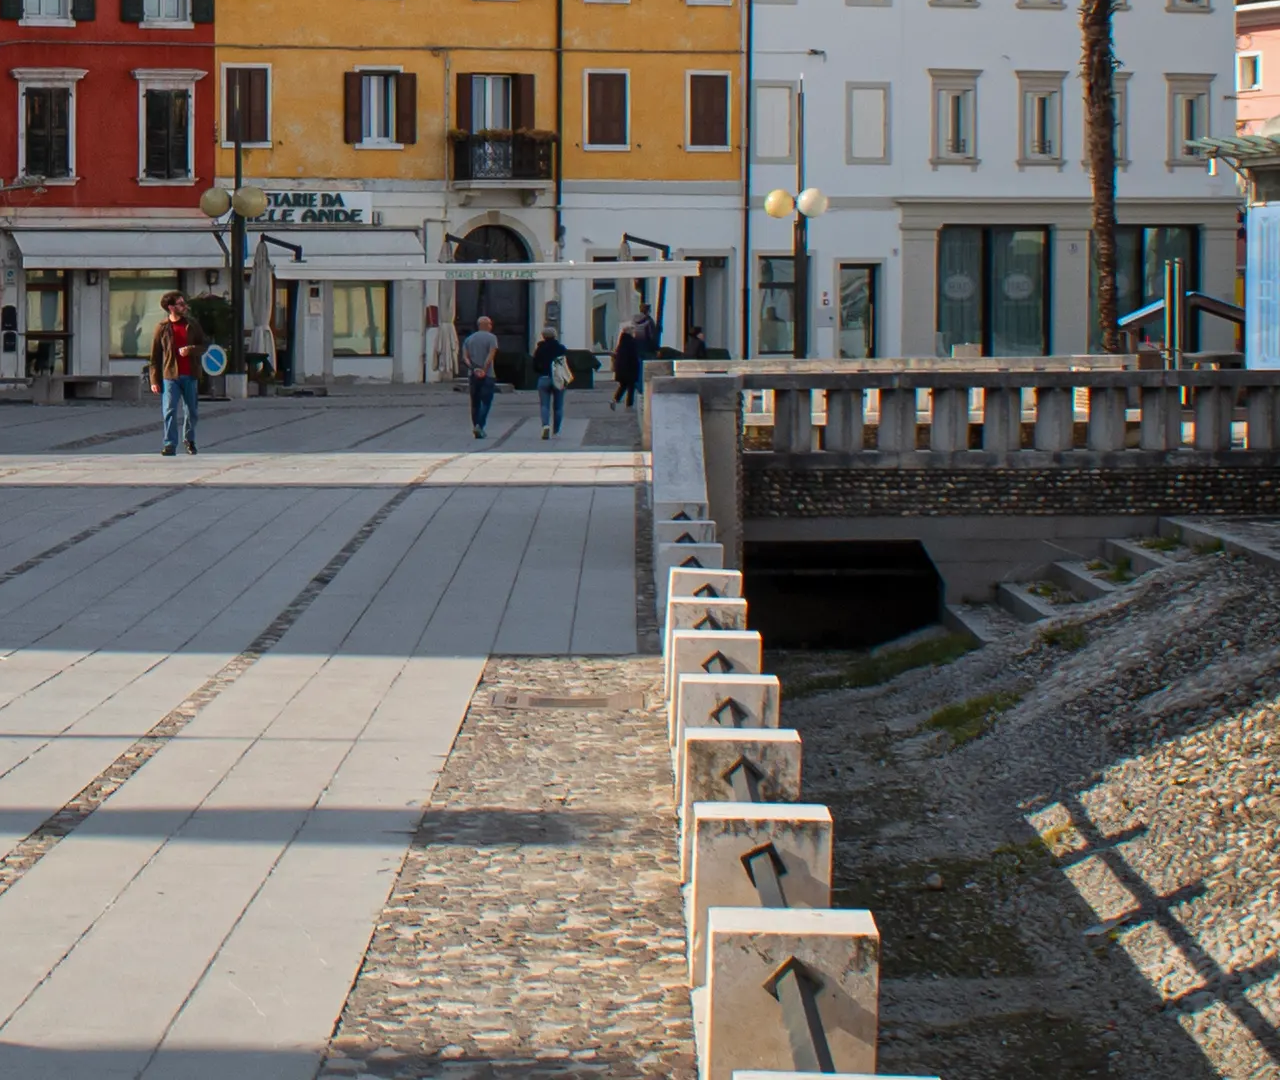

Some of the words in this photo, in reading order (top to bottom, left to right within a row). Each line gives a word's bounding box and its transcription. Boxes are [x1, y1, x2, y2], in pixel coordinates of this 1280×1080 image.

[265, 192, 317, 208] STARIE
[321, 192, 345, 208] DA
[301, 208, 363, 223] ANDE
